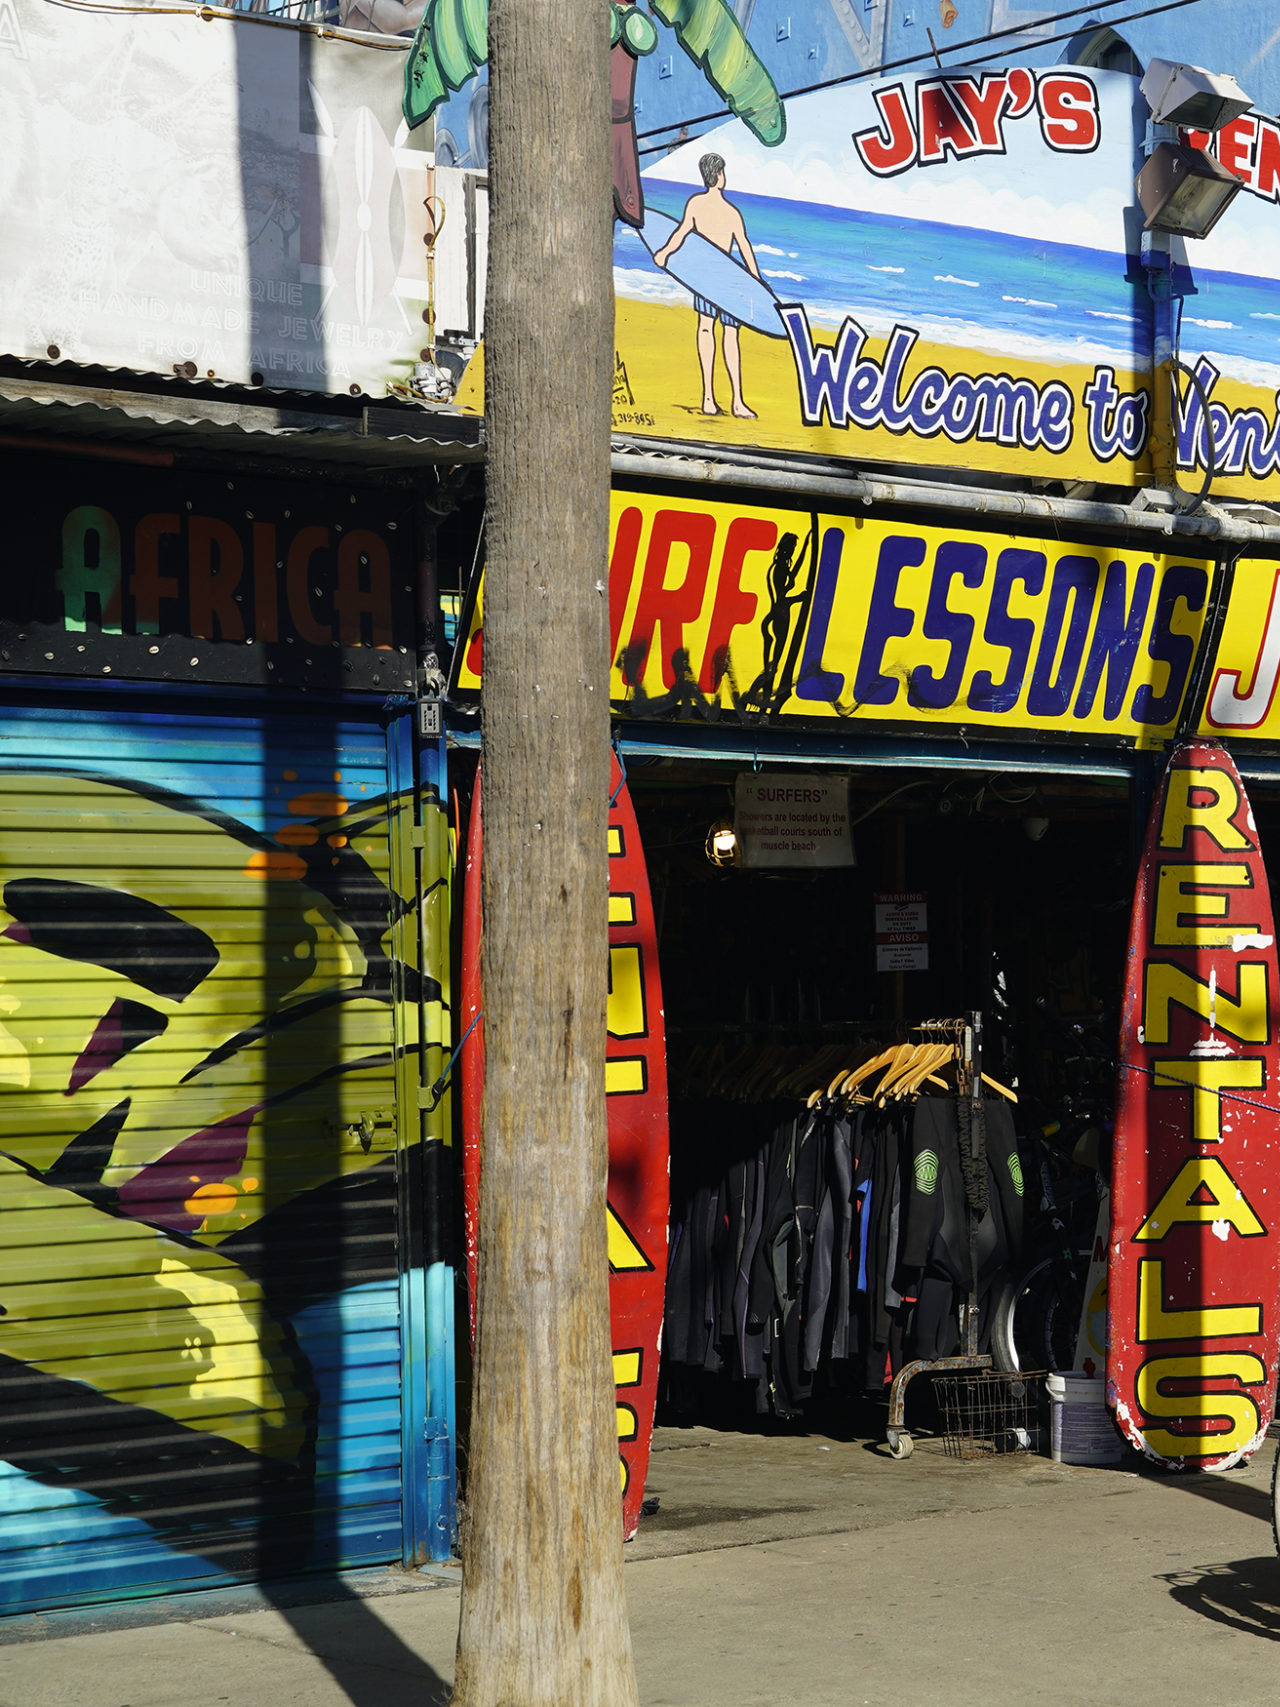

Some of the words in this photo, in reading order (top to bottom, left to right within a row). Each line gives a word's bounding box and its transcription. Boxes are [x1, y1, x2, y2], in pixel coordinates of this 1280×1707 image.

[853, 67, 1100, 177] JAY'S
[190, 271, 303, 305] UNIQUE
[79, 290, 260, 336] HANDMADE
[278, 315, 405, 352] JEWELRY
[137, 331, 226, 362] FROM
[250, 348, 351, 380] AFRICA
[778, 303, 1073, 452] Welcome
[1086, 367, 1149, 462] to
[55, 505, 394, 650] AFRICA
[796, 526, 1208, 725] LESSONS
[780, 827, 806, 836] courts
[807, 827, 831, 837] south
[833, 827, 843, 837] of
[789, 812, 818, 822] located
[820, 813, 830, 824] by
[832, 813, 846, 823] the
[761, 841, 789, 850] muscle
[791, 841, 816, 851] beach
[881, 893, 922, 902] WARNING
[889, 933, 920, 942] AVISO
[1131, 766, 1269, 1459] RENTALS
